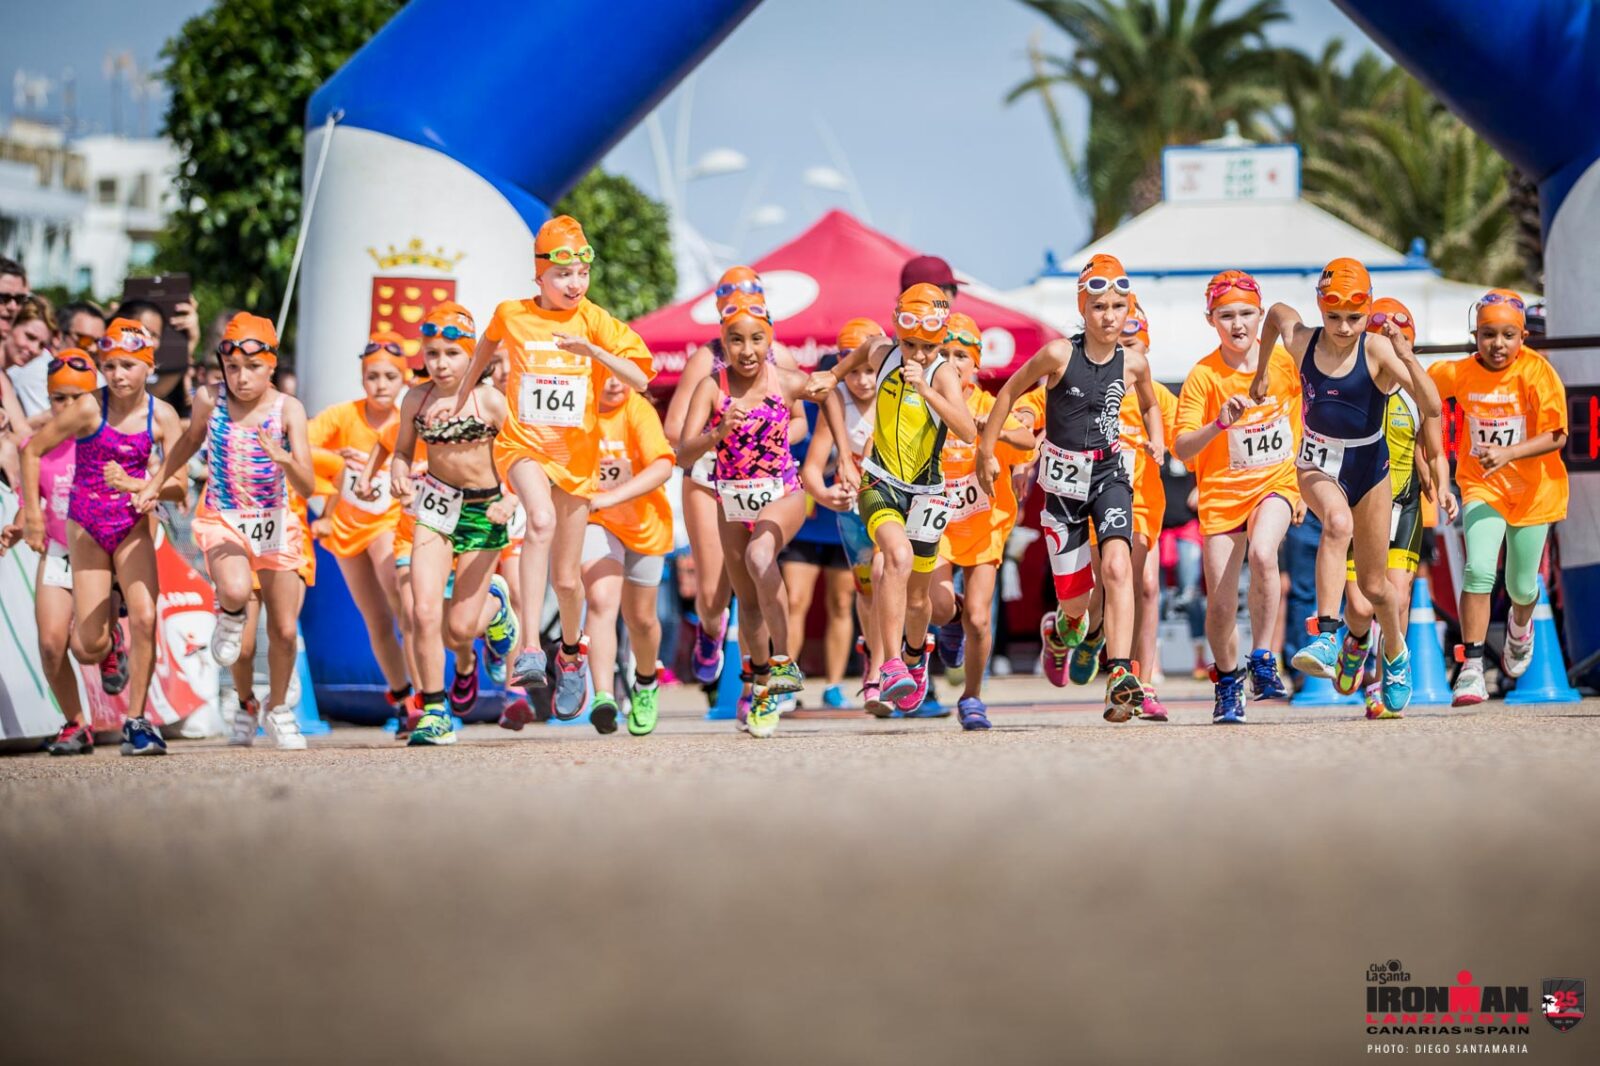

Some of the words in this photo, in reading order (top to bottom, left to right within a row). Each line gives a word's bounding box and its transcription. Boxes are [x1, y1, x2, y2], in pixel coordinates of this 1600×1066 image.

[536, 376, 569, 385] IRONKIDS
[532, 388, 575, 411] 164
[1243, 430, 1283, 457] 146
[1478, 429, 1514, 447] 167
[1045, 456, 1079, 484] 152
[423, 492, 451, 515] 65
[733, 491, 772, 511] 168
[237, 520, 275, 542] 149
